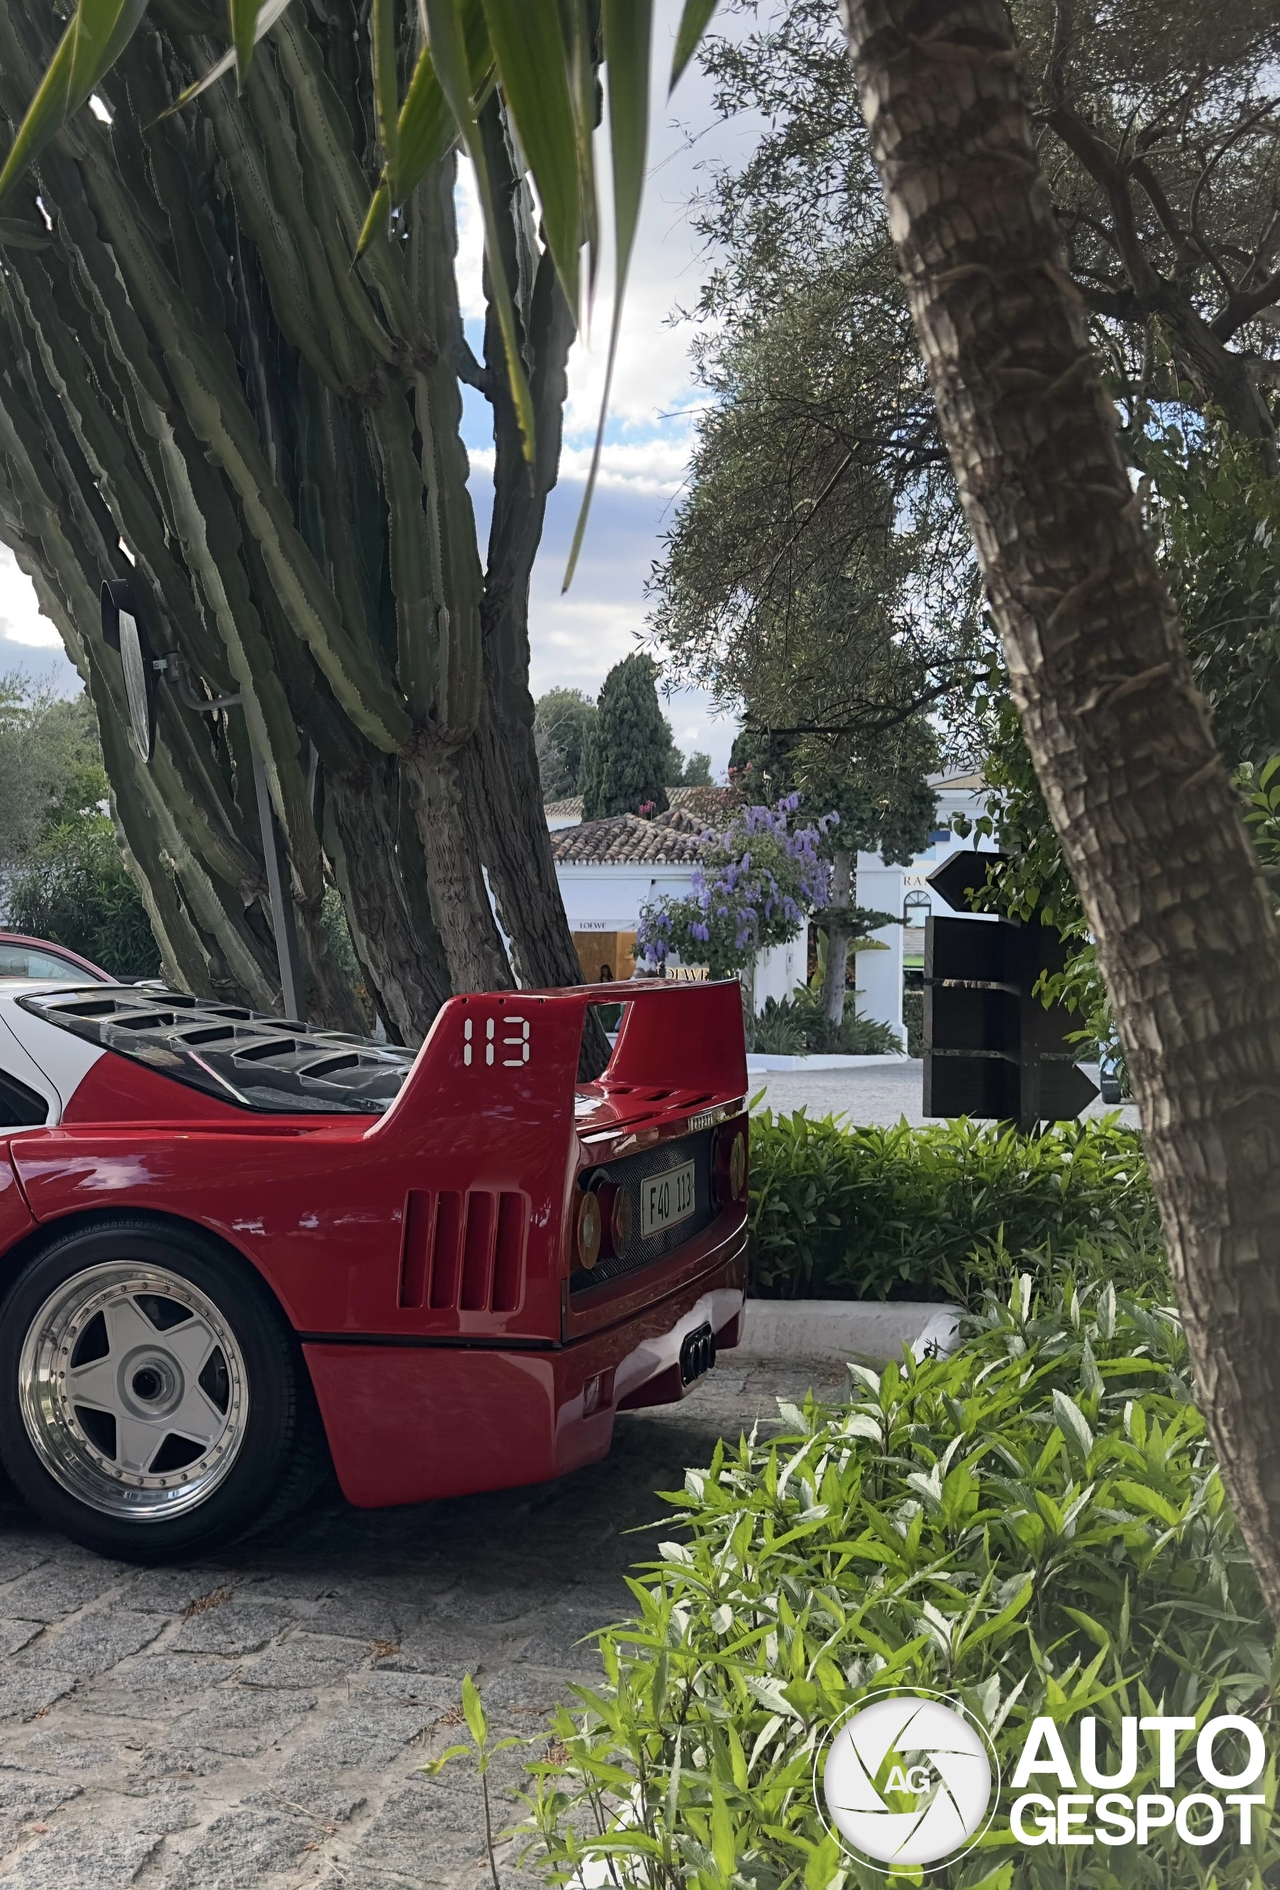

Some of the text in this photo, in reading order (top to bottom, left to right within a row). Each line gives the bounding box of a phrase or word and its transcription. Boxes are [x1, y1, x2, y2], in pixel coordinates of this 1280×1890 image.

[664, 966, 710, 981] OEWE
[463, 1016, 530, 1067] 113
[650, 1172, 691, 1225] F40 113
